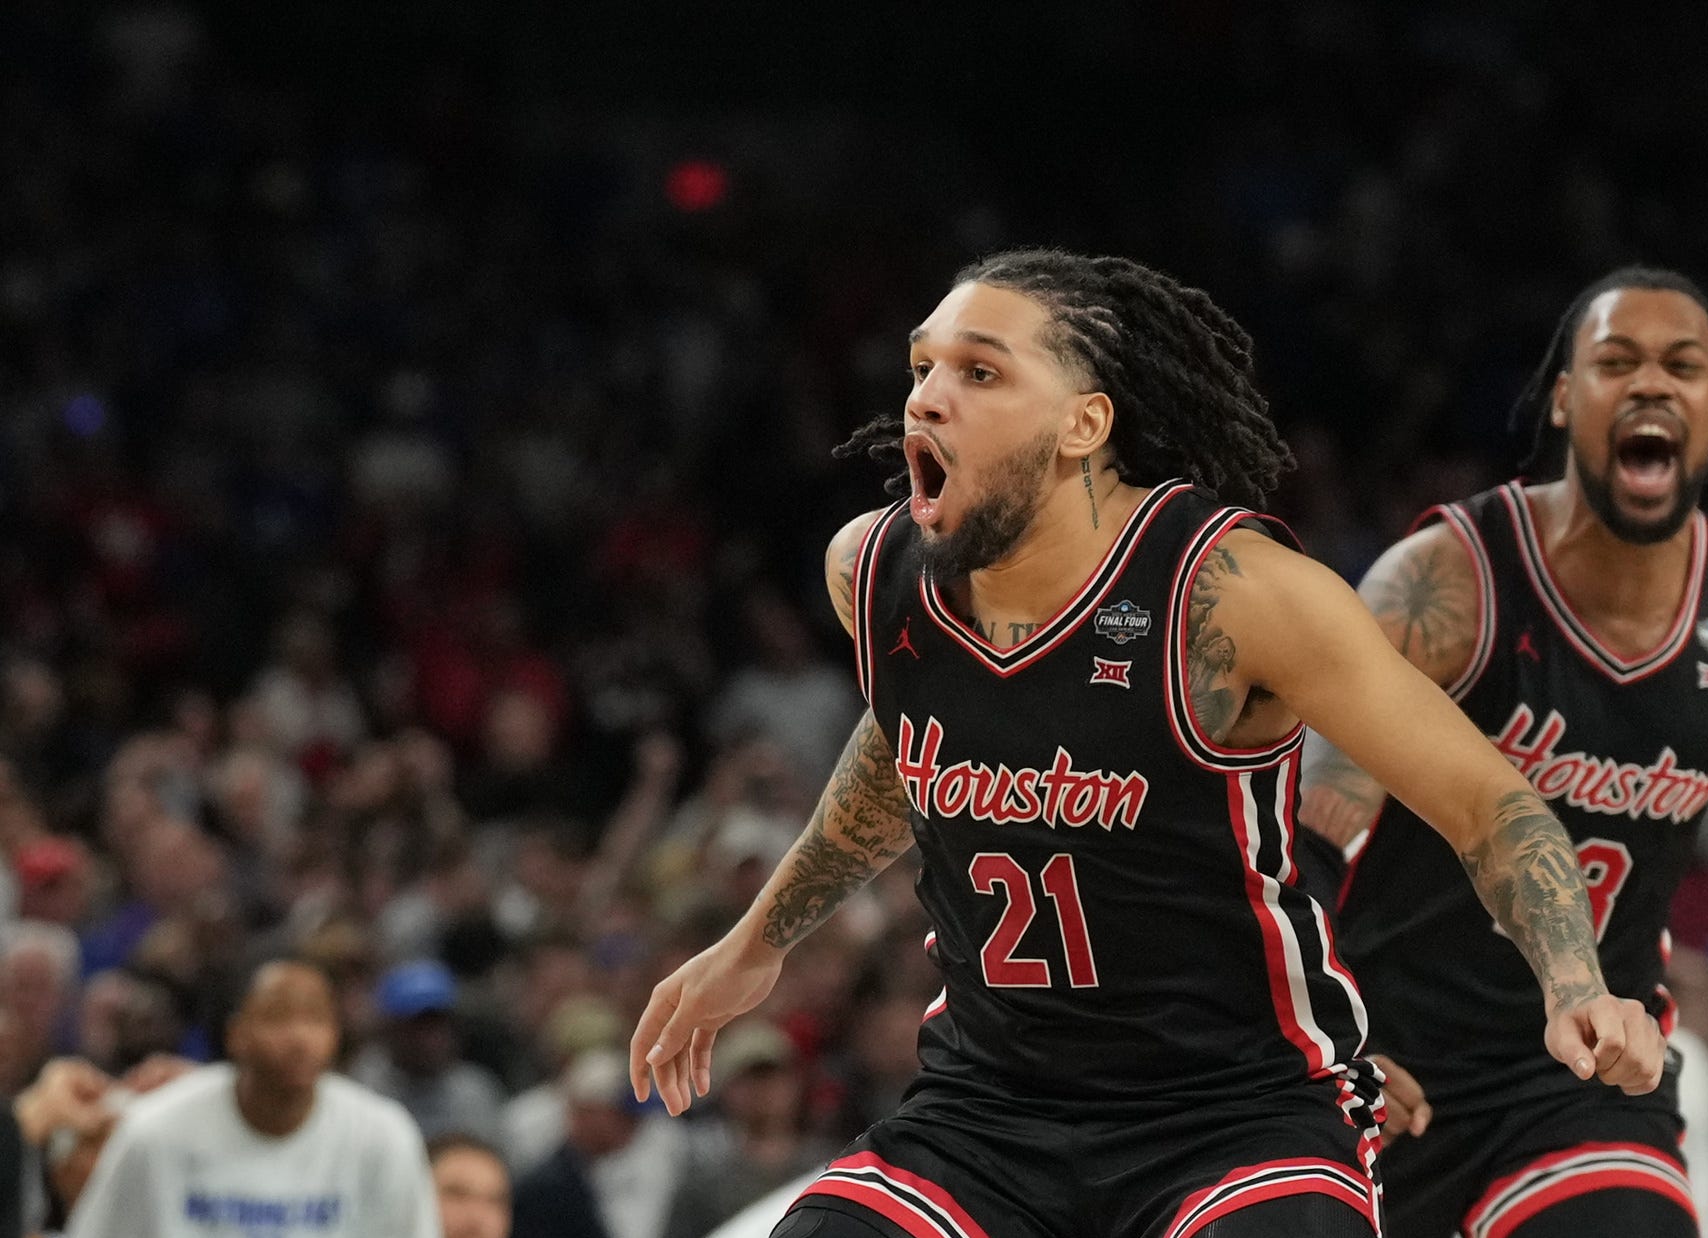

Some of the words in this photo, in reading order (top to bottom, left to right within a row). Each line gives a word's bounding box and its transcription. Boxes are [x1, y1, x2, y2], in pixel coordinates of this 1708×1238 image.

[1098, 615, 1123, 626] FINAL
[1124, 616, 1148, 627] FOUR
[896, 713, 1148, 831] Houston
[968, 853, 1099, 988] 21
